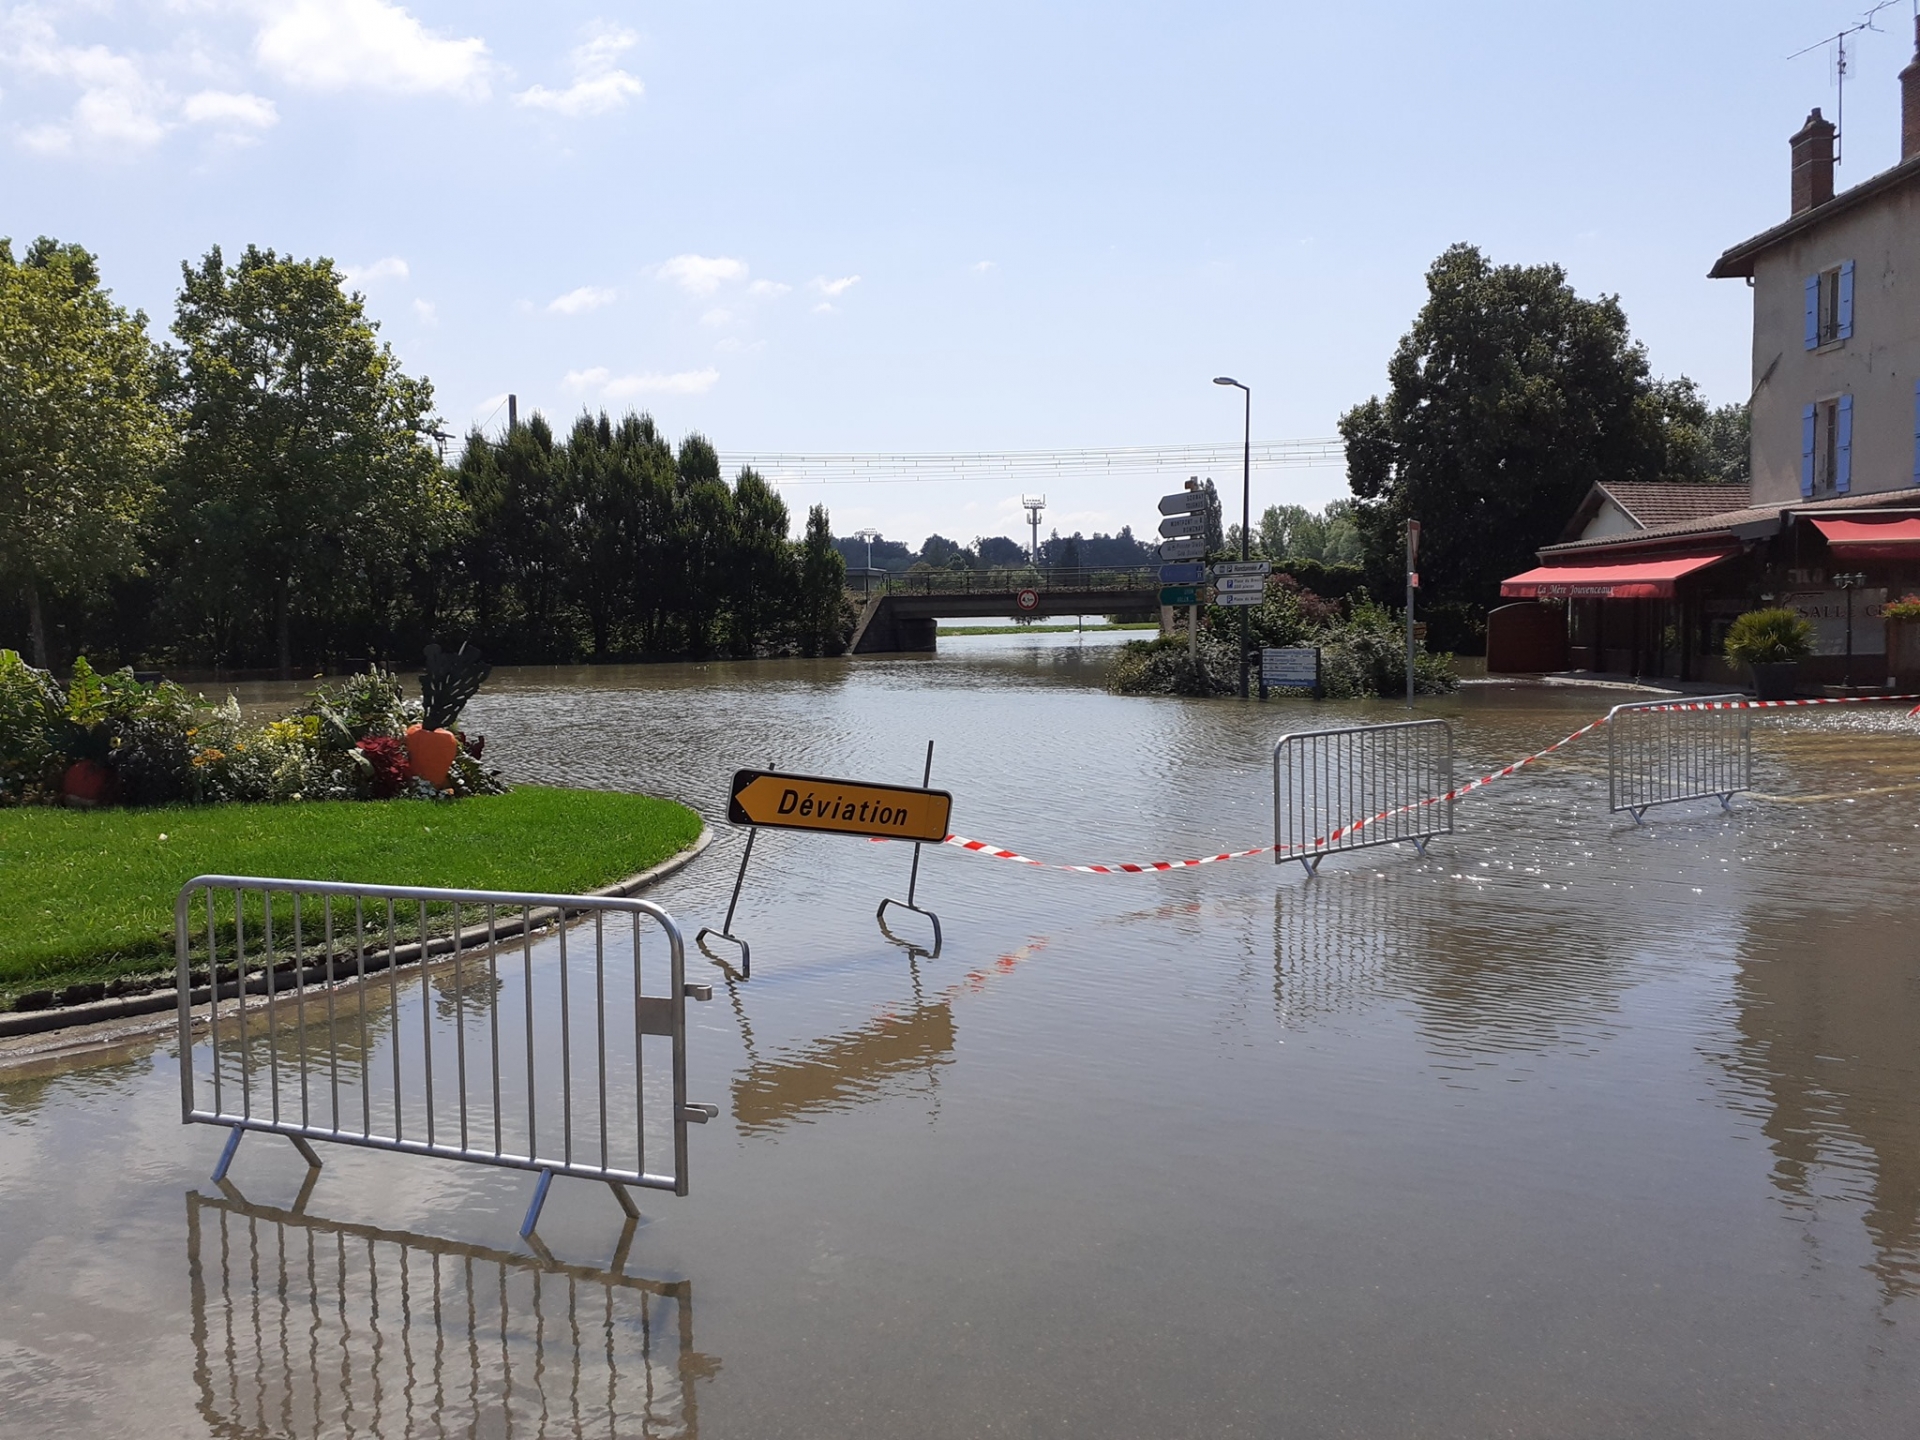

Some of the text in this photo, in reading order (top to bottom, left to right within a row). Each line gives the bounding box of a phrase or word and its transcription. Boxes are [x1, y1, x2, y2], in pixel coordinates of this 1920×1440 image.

[1537, 584, 1615, 596] La Mère Jouvenceaux
[777, 789, 908, 826] Déviation
